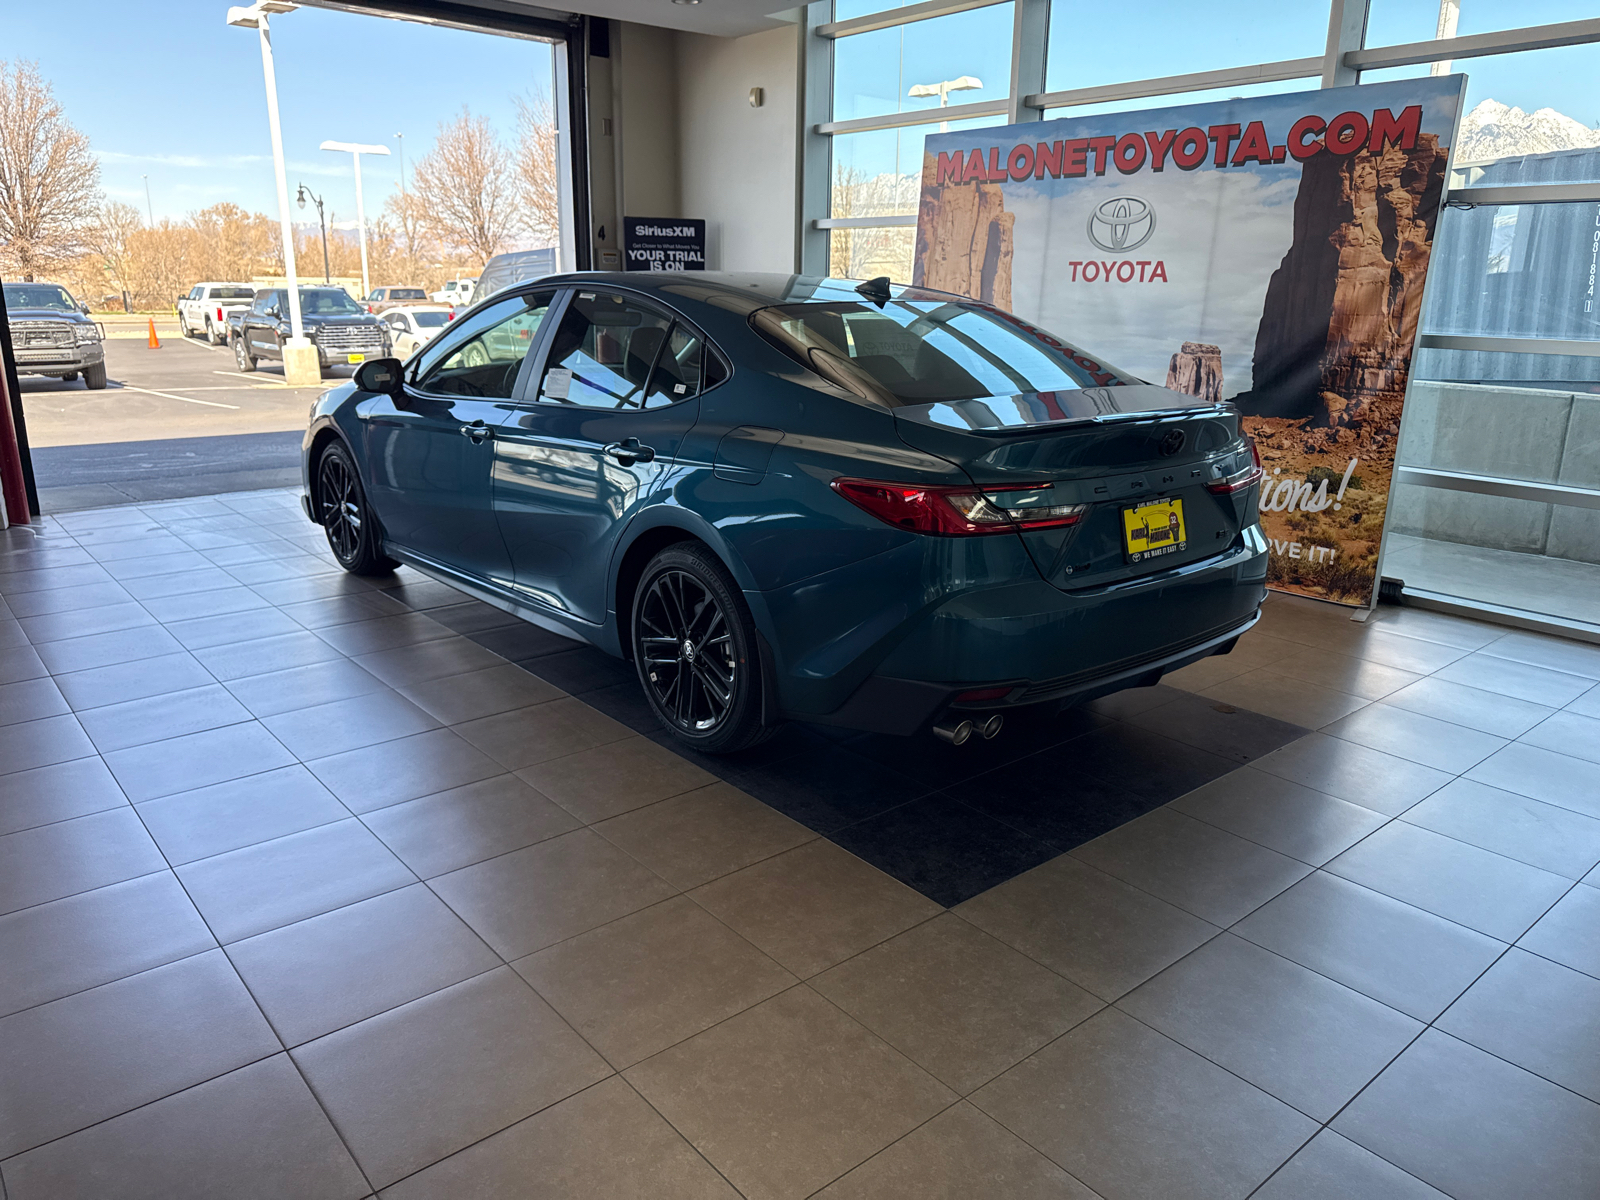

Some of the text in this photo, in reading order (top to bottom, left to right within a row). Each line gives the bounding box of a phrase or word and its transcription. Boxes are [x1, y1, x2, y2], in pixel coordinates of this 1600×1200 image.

[936, 104, 1422, 186] MALONETOYOTA.COM
[598, 225, 606, 241] 4
[635, 225, 696, 237] SiriusXM
[628, 250, 665, 261] YOUR
[667, 250, 705, 262] TRIAL
[1588, 230, 1600, 296] 081884
[650, 261, 685, 271] IS ON
[1068, 260, 1168, 283] TOYOTA
[1170, 516, 1177, 524] 32
[1151, 549, 1162, 557] MAKE
[1167, 545, 1177, 553] EASY
[1308, 545, 1335, 565] IT!
